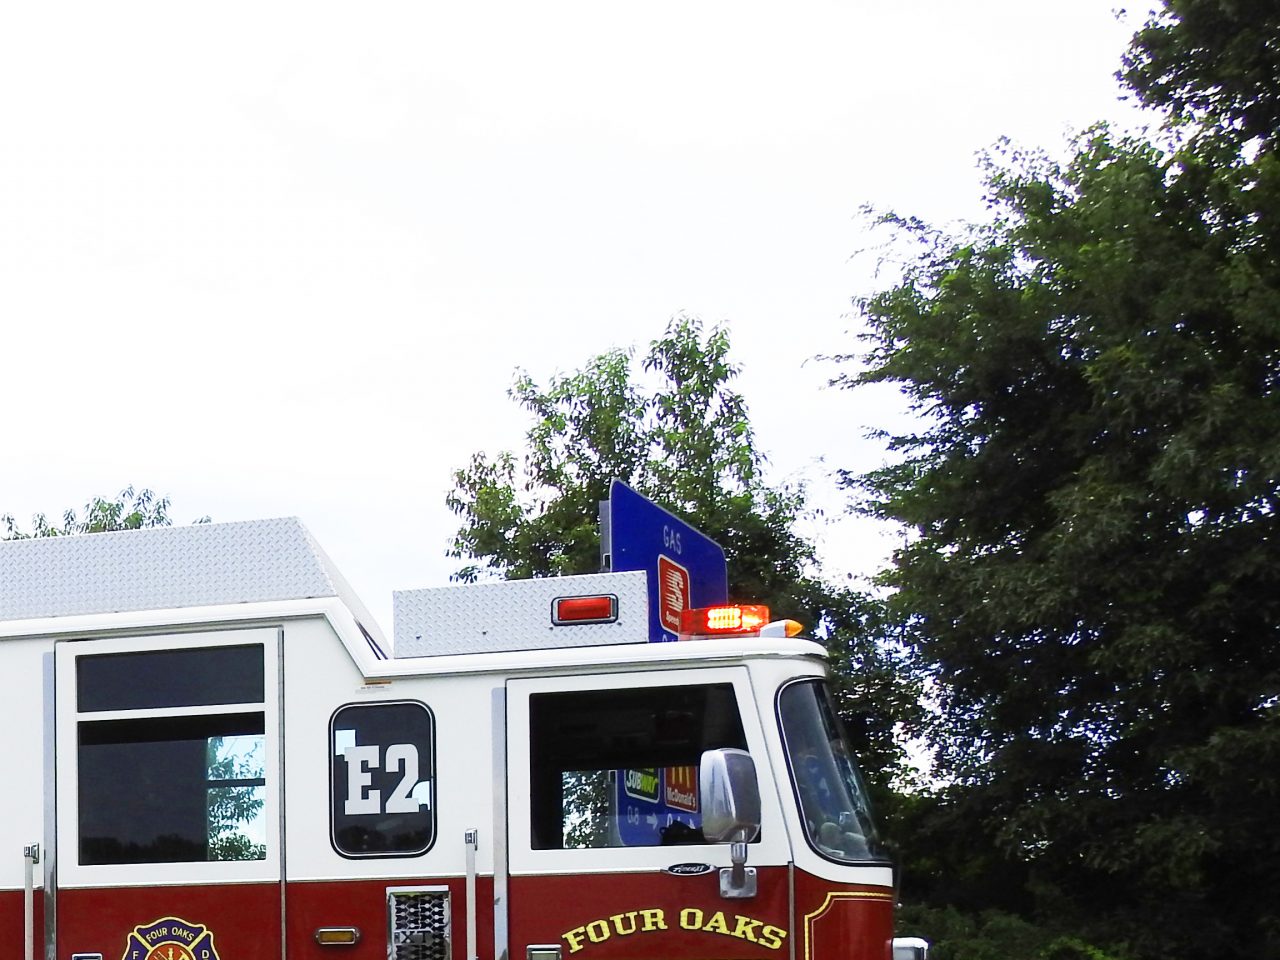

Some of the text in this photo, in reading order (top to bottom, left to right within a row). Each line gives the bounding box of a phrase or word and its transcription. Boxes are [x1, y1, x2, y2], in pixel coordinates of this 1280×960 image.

[663, 525, 682, 555] GAS
[344, 743, 420, 815] E2
[626, 769, 658, 793] SUBWAY
[666, 786, 696, 808] McDonald's
[146, 926, 195, 943] FOUR OAKS
[562, 908, 787, 953] FOUR OAKS
